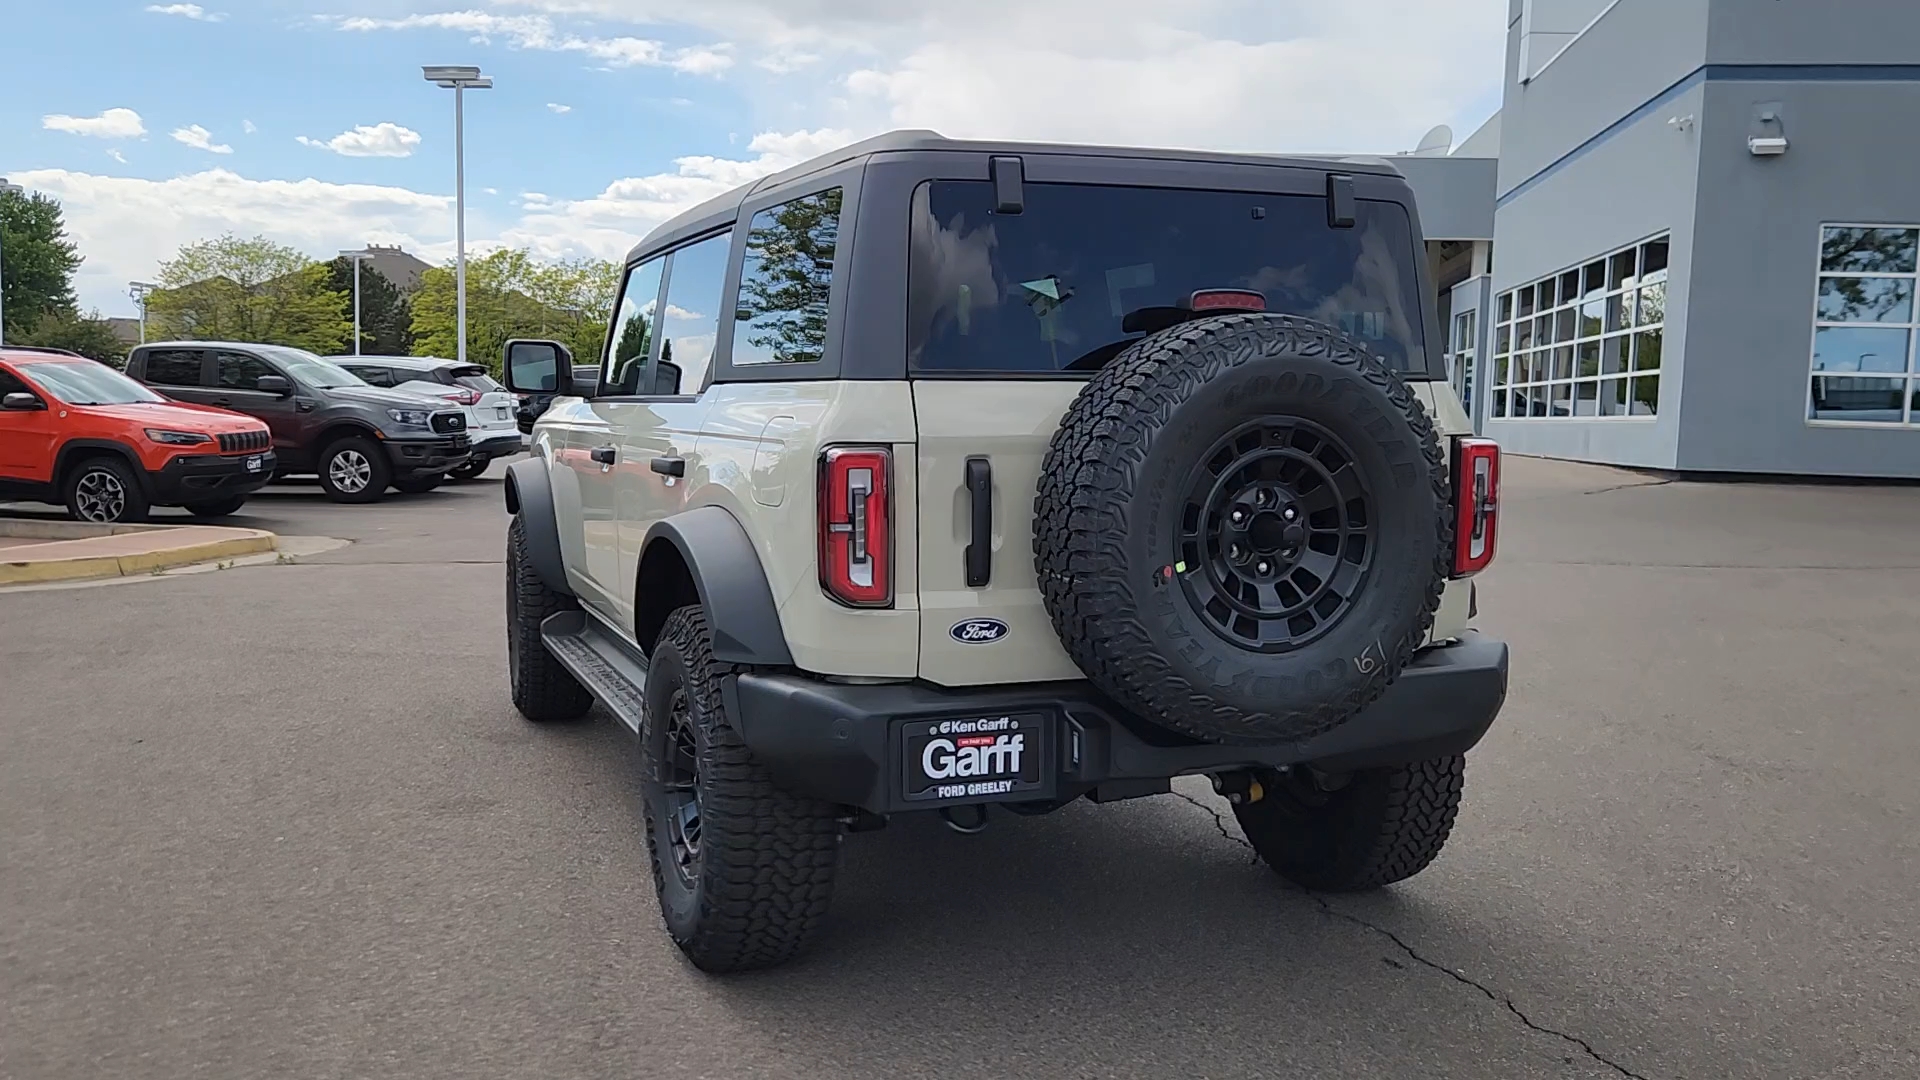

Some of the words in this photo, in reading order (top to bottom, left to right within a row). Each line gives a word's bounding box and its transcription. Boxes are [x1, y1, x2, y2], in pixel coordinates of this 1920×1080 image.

[962, 622, 999, 639] Ford
[951, 720, 977, 733] Ken
[977, 717, 1009, 731] Garff
[922, 733, 1024, 780] Garff
[938, 785, 966, 798] FORD
[967, 780, 1013, 795] GREELEY
